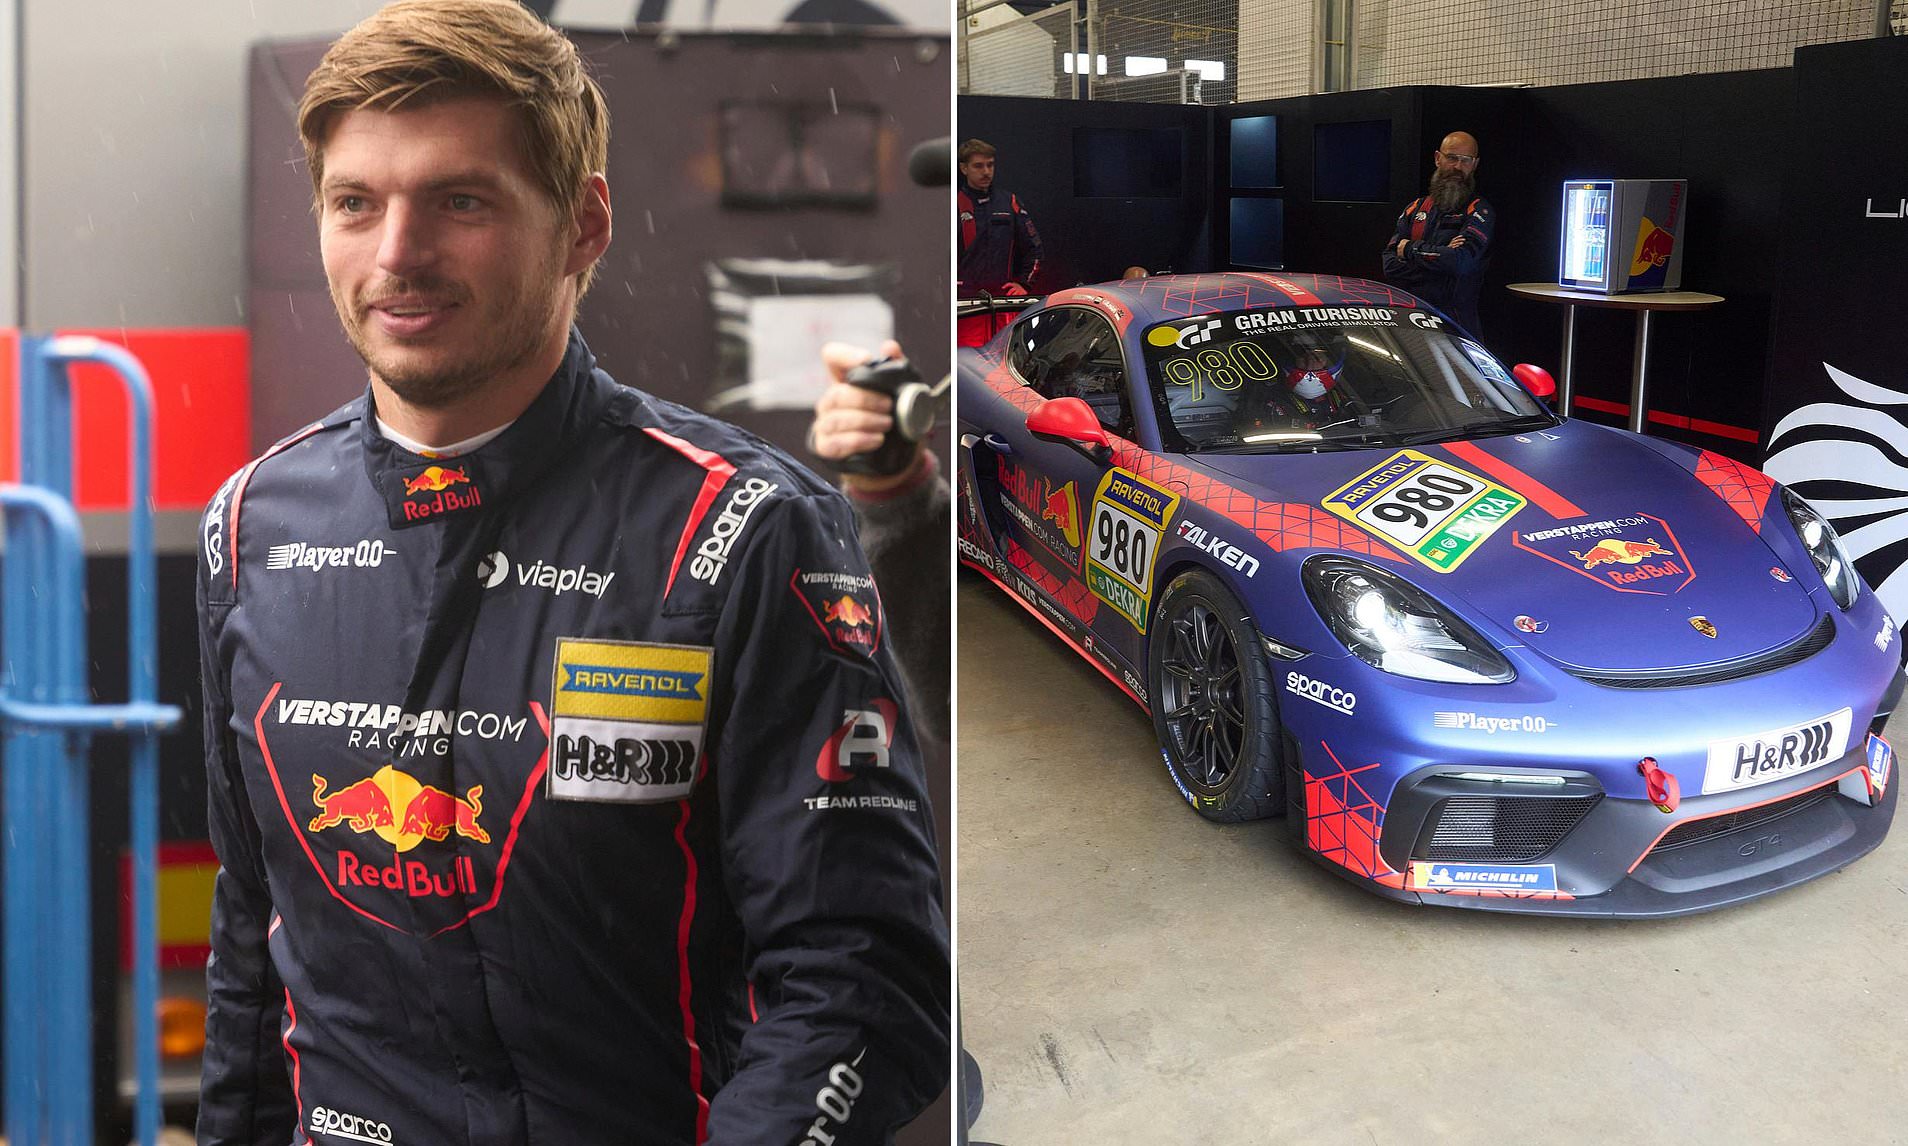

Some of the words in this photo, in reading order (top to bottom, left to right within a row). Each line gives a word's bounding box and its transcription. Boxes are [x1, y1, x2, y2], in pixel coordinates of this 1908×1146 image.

[1235, 310, 1297, 330] GRAN
[1268, 325, 1297, 333] REAL
[1297, 321, 1340, 329] DRIVING
[1165, 341, 1278, 402] 980
[998, 452, 1018, 497] Red
[1018, 468, 1042, 516] Bull
[1110, 479, 1162, 516] RAVENOL
[1342, 460, 1416, 504] RAVENOL
[402, 494, 443, 521] Red
[446, 485, 482, 510] Bull
[1371, 473, 1474, 529] 980
[1444, 497, 1517, 542] DEKRA
[690, 477, 778, 585] sparco
[1099, 509, 1147, 585] 980
[1522, 516, 1649, 543] VERSTAPPEN.COM
[1571, 527, 1623, 542] RACING
[287, 541, 354, 572] Player
[958, 537, 995, 570] RECARO
[1176, 519, 1261, 579] FALKEN
[517, 560, 615, 600] viaplay
[1608, 565, 1650, 585] Red
[1646, 560, 1685, 579] Bull
[1104, 575, 1143, 625] DEKRA
[575, 671, 690, 693] RAVENOL
[1286, 671, 1356, 716] sparco
[1457, 712, 1521, 734] Player
[348, 730, 450, 757] RACING
[556, 734, 650, 785] H&R
[804, 796, 857, 810] TEAM
[859, 796, 918, 812] REDLINE
[1738, 833, 1783, 857] GT4
[337, 850, 404, 890] Red
[404, 855, 478, 898] Bull
[1454, 870, 1539, 884] MICHELIN
[310, 1106, 394, 1146] sparco
